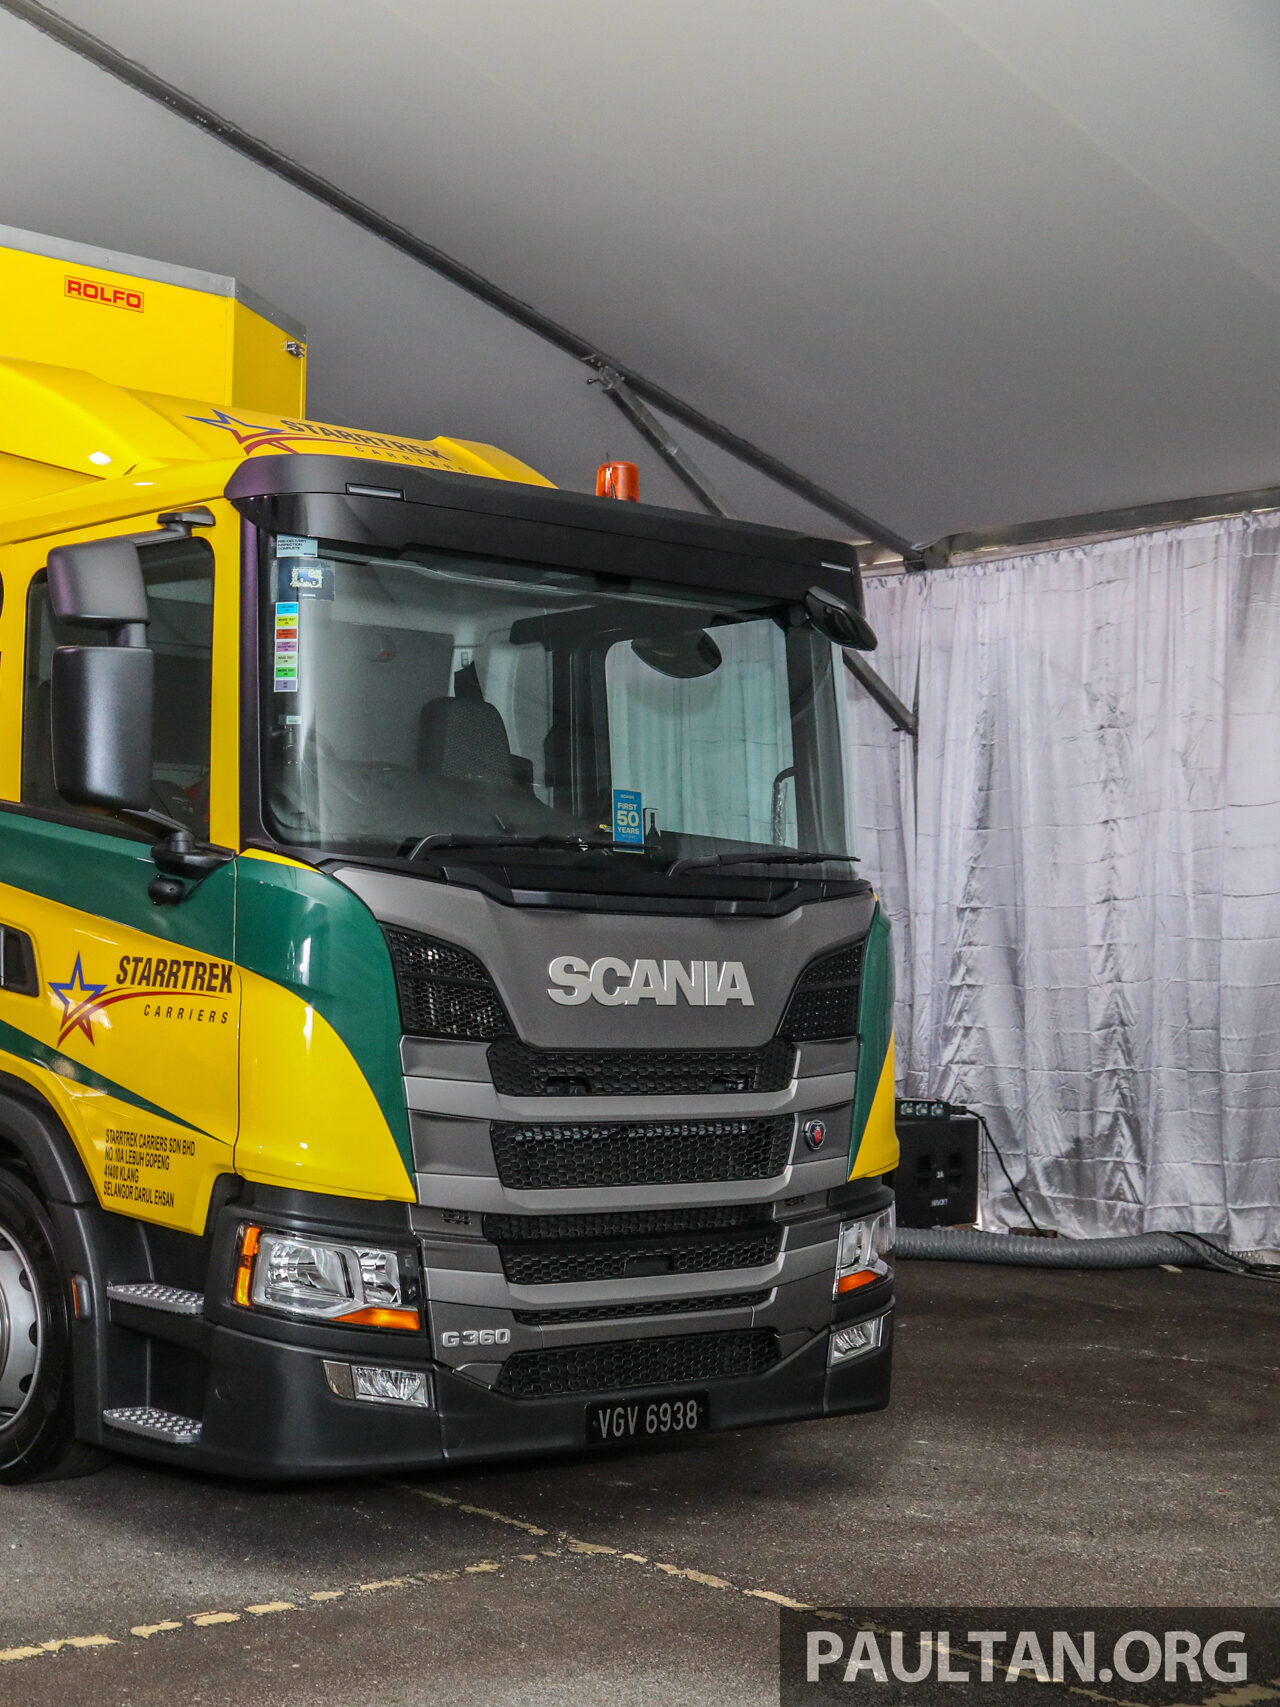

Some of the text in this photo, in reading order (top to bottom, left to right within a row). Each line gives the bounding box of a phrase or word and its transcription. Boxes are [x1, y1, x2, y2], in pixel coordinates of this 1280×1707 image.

[67, 279, 141, 309] ROLFO
[280, 419, 452, 461] STARRTREK
[354, 445, 469, 474] CARRIERS
[617, 802, 637, 811] FIRST
[617, 810, 639, 827] 50
[617, 827, 640, 835] YEARS
[116, 955, 233, 994] STARRTREK
[547, 955, 755, 1007] SCANIA
[143, 1004, 229, 1025] CARRIERS
[105, 1128, 195, 1156] STARRTREK CARRIERS SDN BHD
[104, 1164, 139, 1183] 41400 KLANG
[125, 1150, 144, 1167] LEBUH
[145, 1152, 170, 1171] GOPENG
[103, 1180, 174, 1208] SELANGOR DARUL EHSAN
[598, 1398, 699, 1440] VGV 6938
